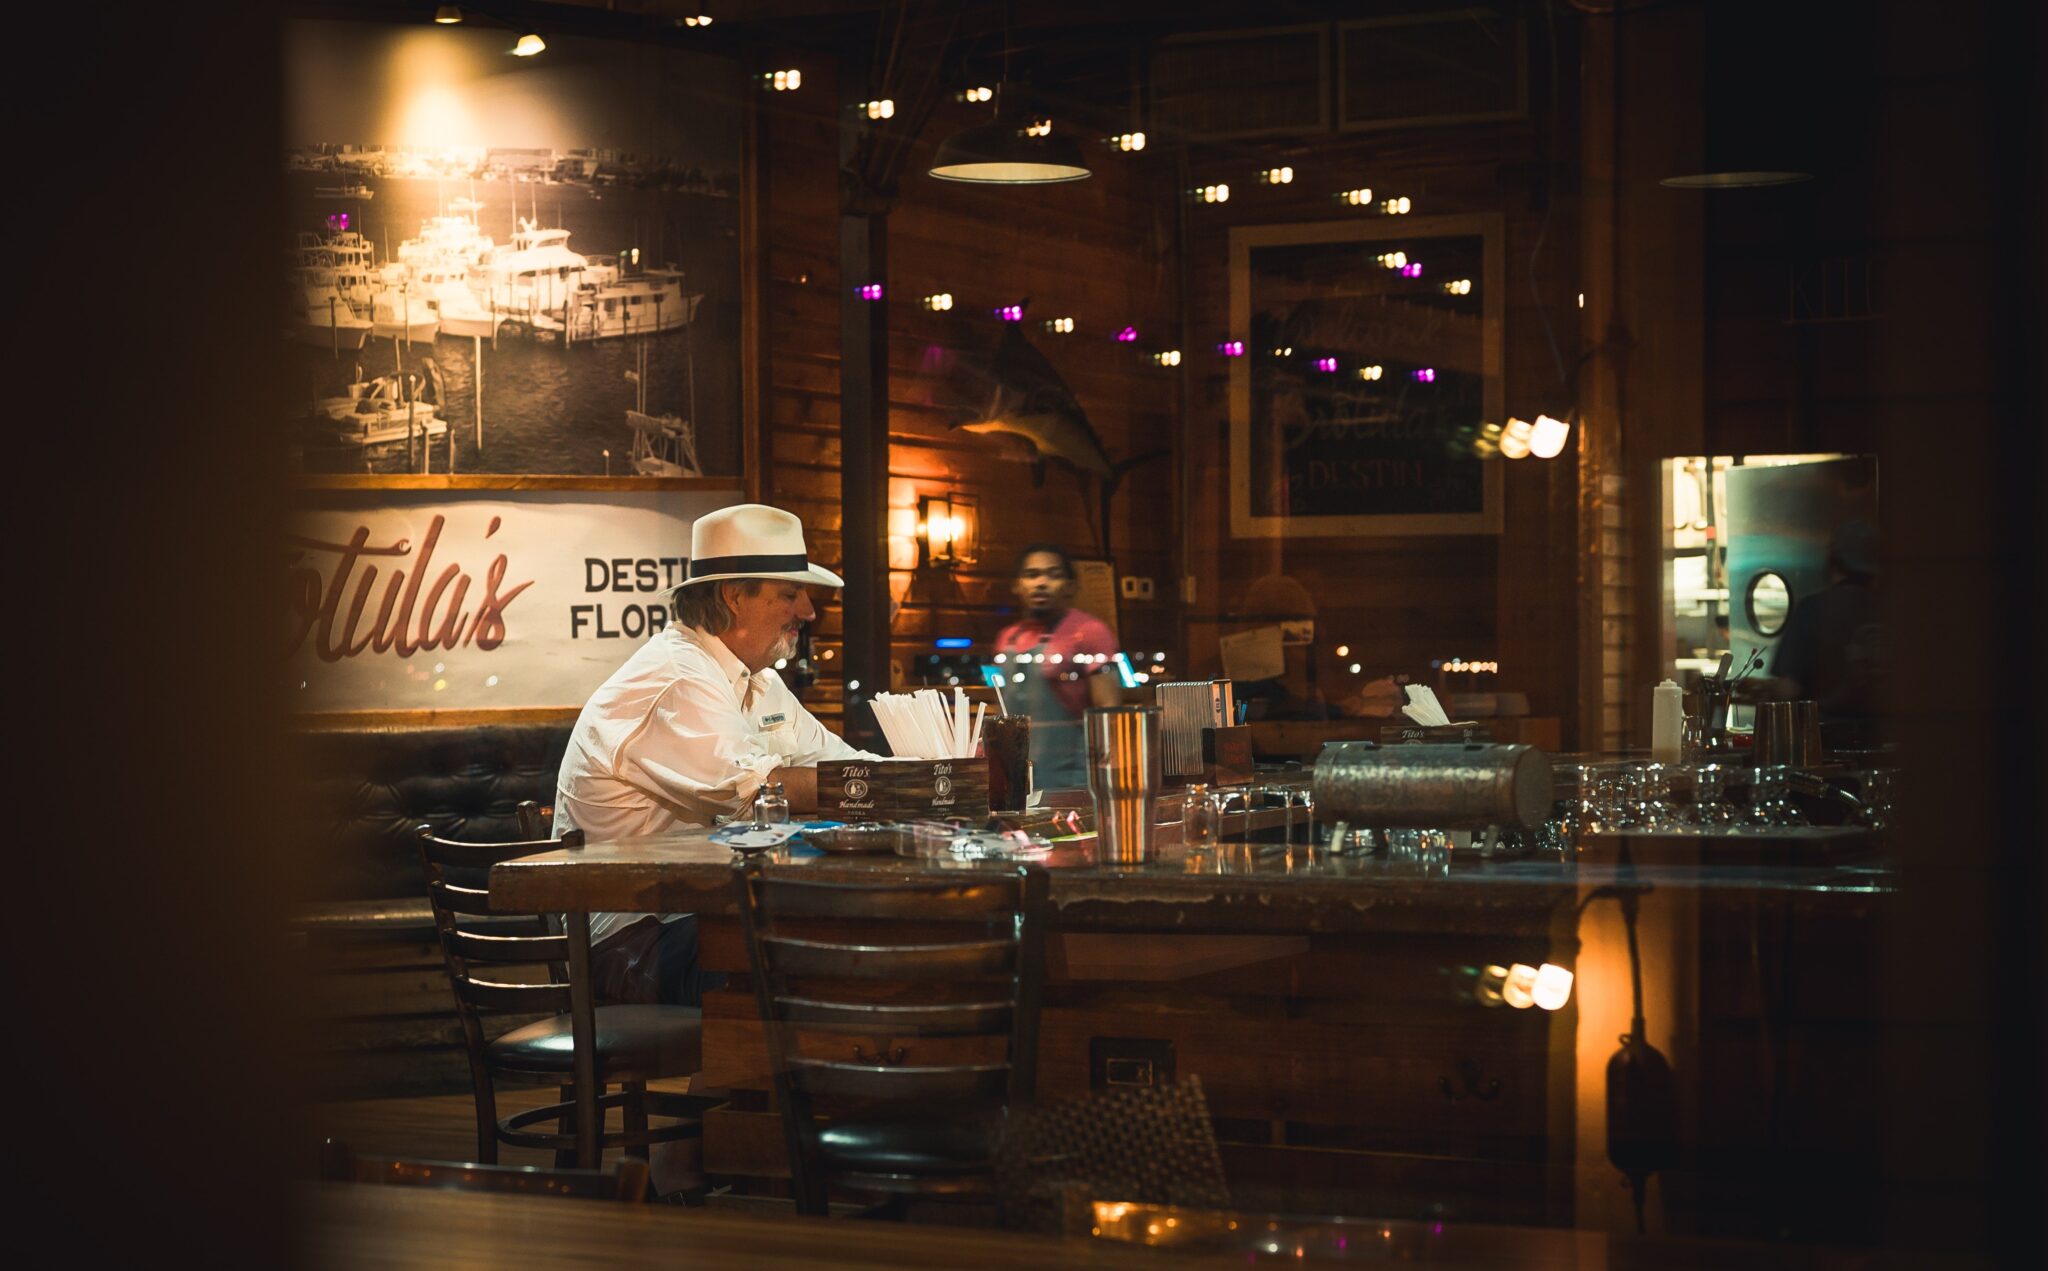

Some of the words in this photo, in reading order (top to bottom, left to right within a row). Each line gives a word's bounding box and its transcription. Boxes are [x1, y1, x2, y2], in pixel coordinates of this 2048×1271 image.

[584, 557, 689, 592] DESTI
[571, 603, 676, 638] FLOR
[1402, 729, 1425, 739] Tito's
[842, 765, 870, 778] Tito's
[933, 763, 953, 776] Tito's
[839, 799, 874, 809] Handmade
